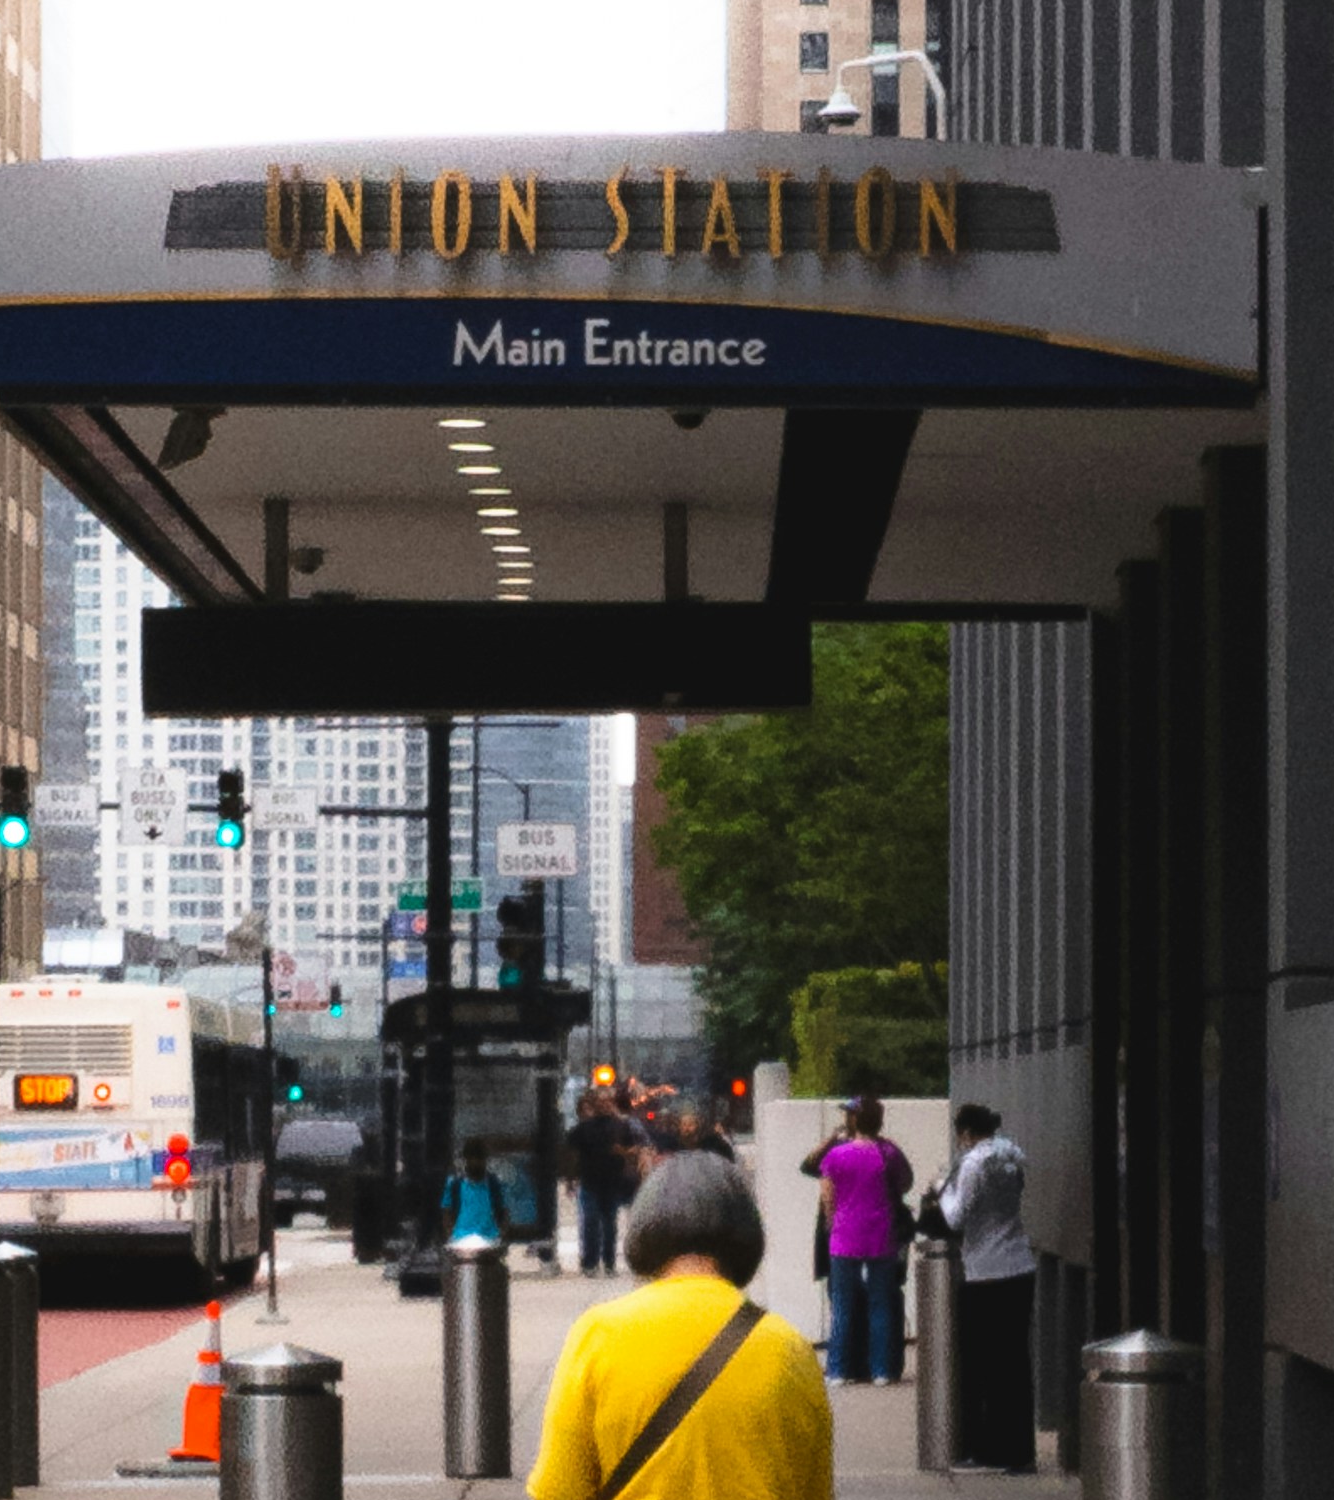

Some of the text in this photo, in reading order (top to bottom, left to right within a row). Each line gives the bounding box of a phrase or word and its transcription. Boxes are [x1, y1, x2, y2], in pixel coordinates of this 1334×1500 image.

[266, 163, 958, 259] UNION STATION
[453, 318, 766, 367] Main Entrance
[139, 772, 166, 788] CTA
[50, 788, 82, 803] BUS
[130, 790, 177, 806] BUSES
[37, 807, 91, 823] SIGNAL
[133, 808, 171, 824] ONLY
[517, 829, 555, 846] BUS
[502, 854, 571, 871] SIGNAL
[19, 1076, 73, 1103] STOP
